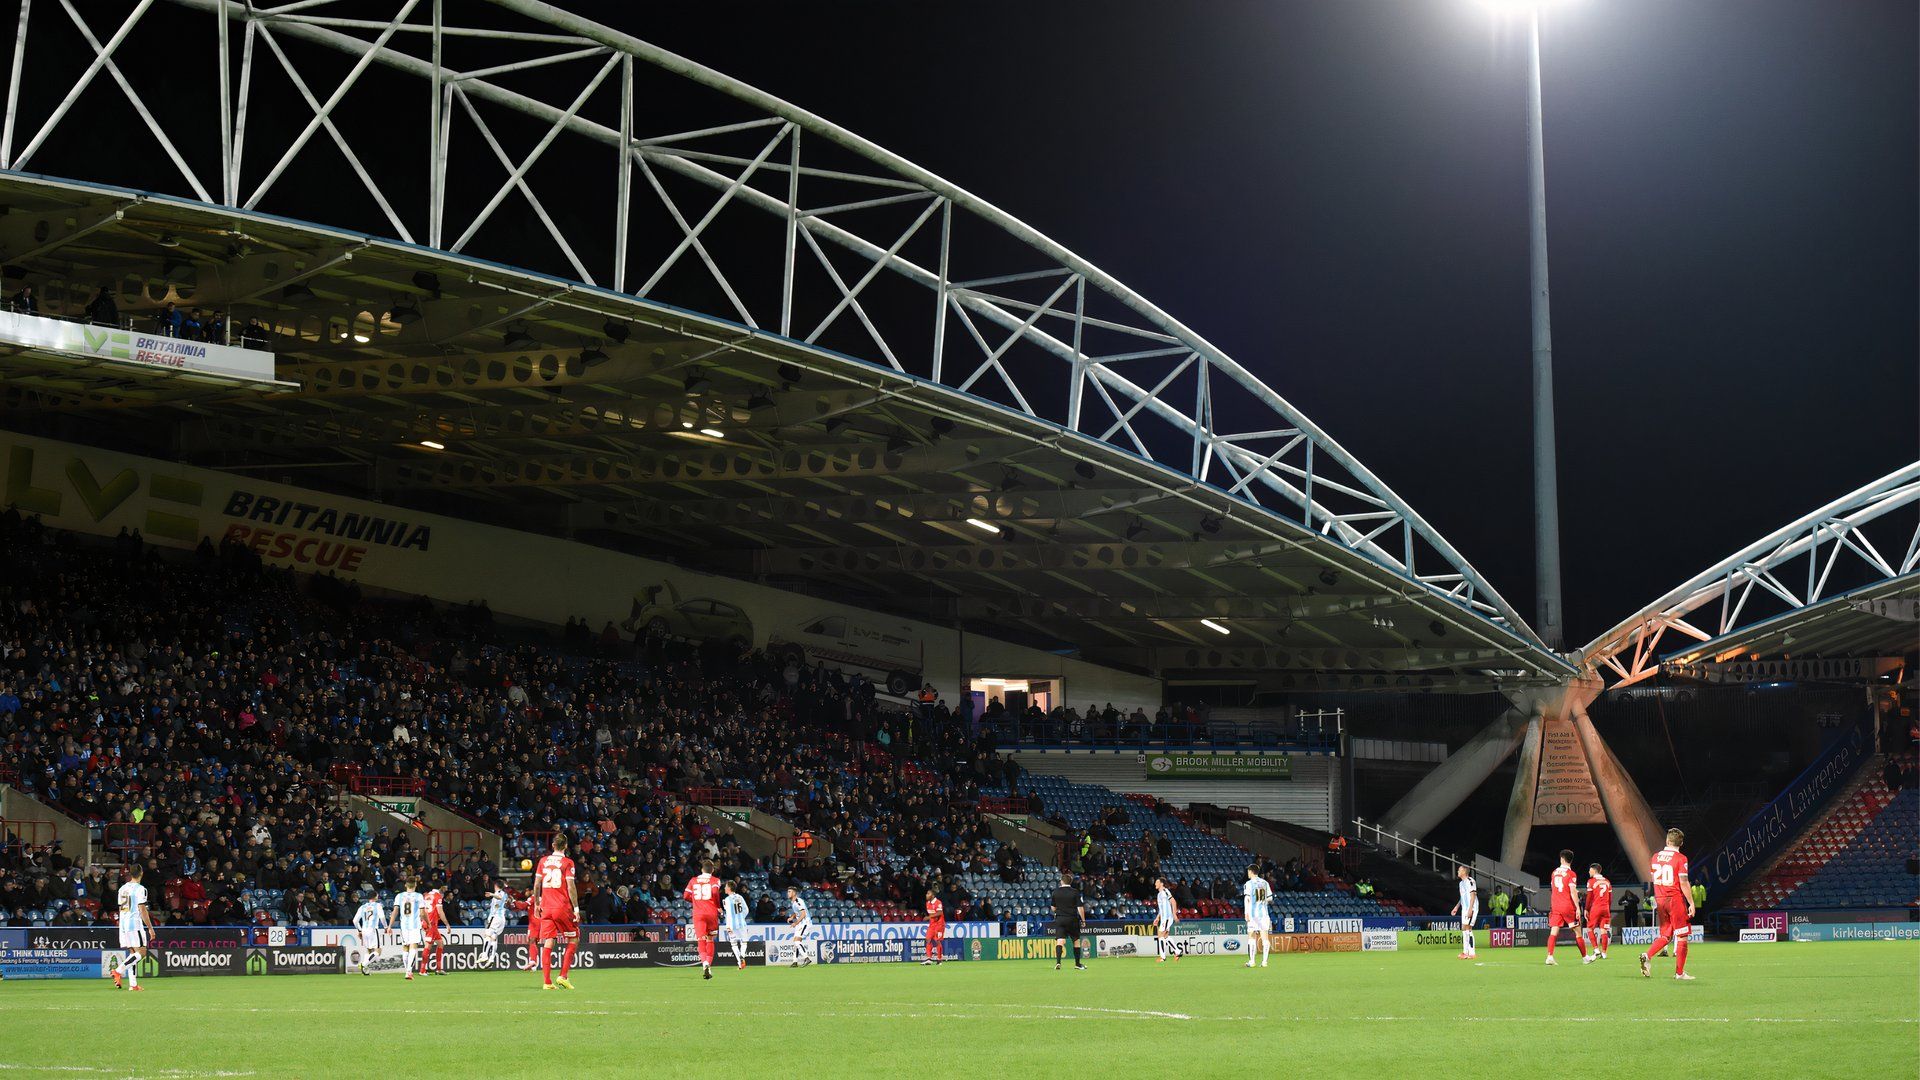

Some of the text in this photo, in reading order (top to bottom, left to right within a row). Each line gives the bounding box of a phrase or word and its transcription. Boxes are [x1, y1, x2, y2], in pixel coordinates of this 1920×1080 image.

[136, 337, 206, 358] BRITANNIA
[136, 350, 185, 368] RESCUE
[223, 490, 430, 552] BRITANNIA
[226, 523, 367, 572] RESCUE
[1176, 757, 1288, 767] BROOK MILLER MOBILITY
[401, 803, 410, 812] 27
[1537, 798, 1601, 818] prohms
[1716, 747, 1849, 884] Chadwick Lawrence
[1651, 863, 1674, 886] 20
[693, 883, 711, 900] 39
[1554, 876, 1563, 892] 4
[404, 902, 411, 915] 8
[734, 903, 743, 914] 16
[1754, 917, 1782, 929] PURE
[270, 930, 283, 943] 28
[1417, 933, 1463, 945] Orchard Ener
[1493, 932, 1511, 946] PURE
[1622, 927, 1659, 937] Walker
[13, 950, 33, 958] THINK
[34, 950, 68, 958] WALKERS
[658, 944, 699, 954] complete offic
[837, 940, 903, 956] Haighs Farm Shop
[997, 939, 1024, 959] JOHN
[165, 950, 232, 967] Towndoor
[272, 950, 337, 966] Towndoor
[671, 953, 701, 962] solutions
[5, 965, 89, 973] www.walker-timber.co.uk
